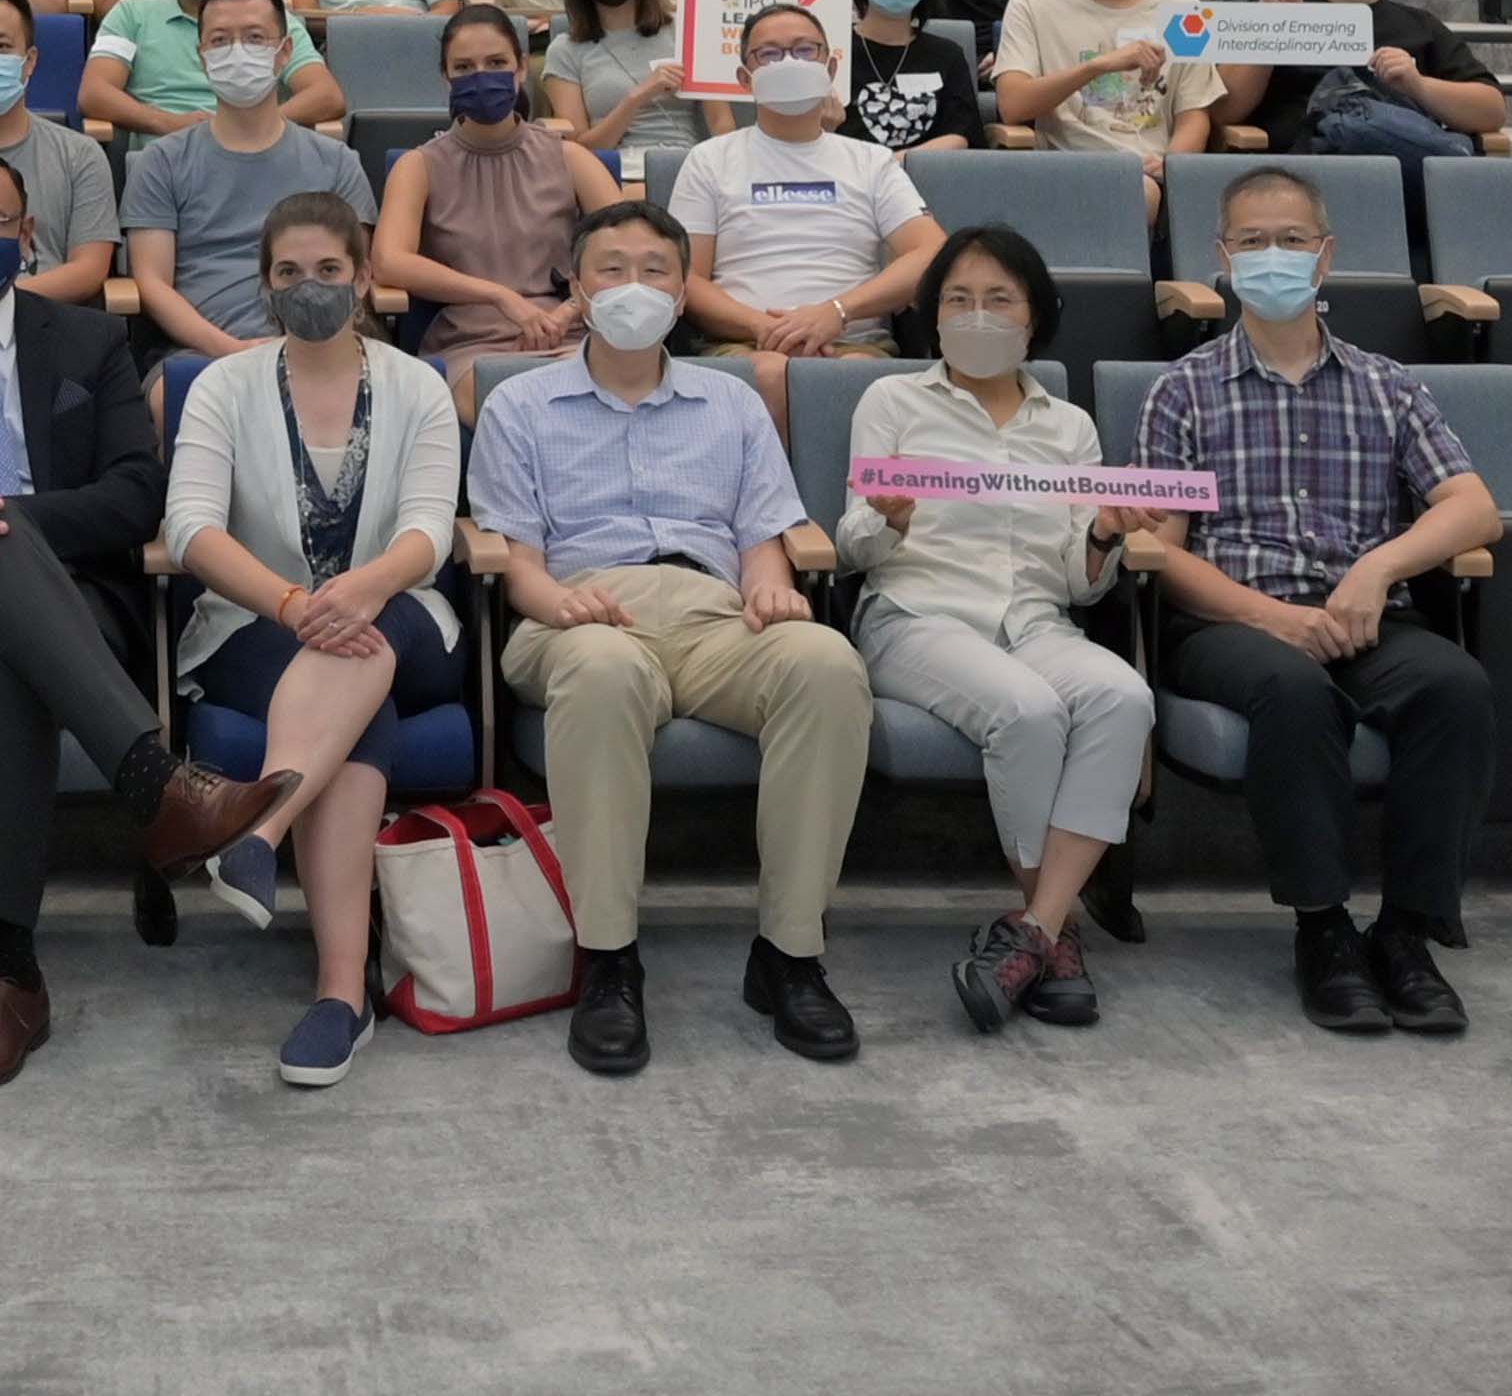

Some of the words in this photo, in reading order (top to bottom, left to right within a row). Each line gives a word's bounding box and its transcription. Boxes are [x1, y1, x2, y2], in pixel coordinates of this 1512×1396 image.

[1217, 19, 1270, 33] Division
[1272, 19, 1288, 33] of
[1289, 20, 1356, 37] Emerging
[1218, 38, 1326, 54] Interdisciplinary
[1327, 40, 1369, 53] Areas
[753, 185, 834, 203] ellesse
[1317, 300, 1329, 313] 20
[860, 468, 1212, 503] #LearningWithoutBoundaries
